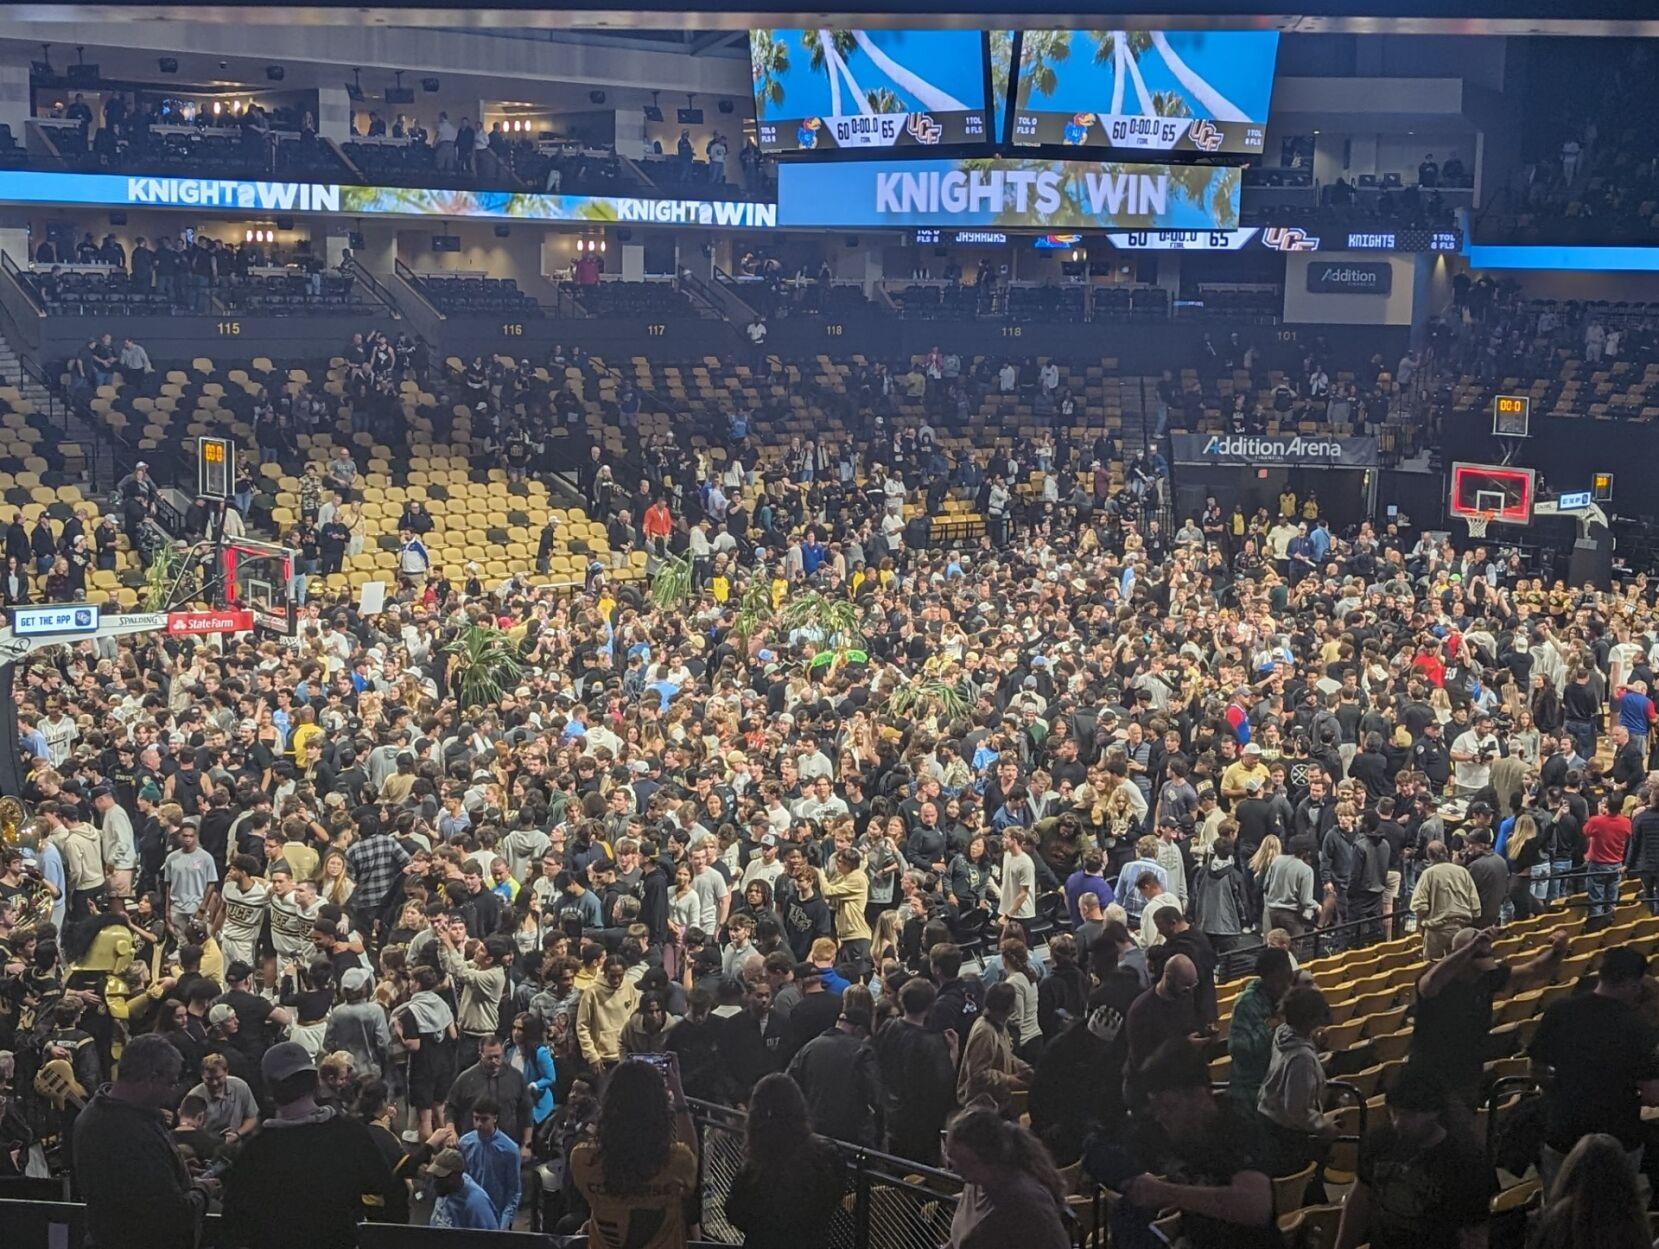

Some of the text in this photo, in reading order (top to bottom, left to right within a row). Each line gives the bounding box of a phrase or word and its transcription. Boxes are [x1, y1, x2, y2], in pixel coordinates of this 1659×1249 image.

[837, 122, 849, 140] 60
[881, 120, 894, 138] 65
[1112, 121, 1126, 139] 60
[1162, 124, 1176, 141] 65
[256, 182, 339, 211] WIN
[876, 170, 1168, 215] KNIGHTS WIN
[713, 201, 777, 227] WIN
[1128, 232, 1147, 246] 60
[1209, 232, 1229, 247] 65
[1349, 234, 1395, 248] KNIGHTS
[1439, 233, 1456, 241] TOL
[1321, 268, 1377, 282] Addition
[217, 322, 240, 335] 115
[503, 325, 522, 336] 116
[648, 325, 665, 336] 117
[826, 325, 843, 336] 118
[1002, 327, 1022, 337] 118
[1278, 331, 1297, 341] 101
[1203, 436, 1342, 457] Addition Arena
[21, 615, 71, 627] GET THE APP
[119, 616, 158, 626] SPALDING
[227, 902, 253, 921] UCF
